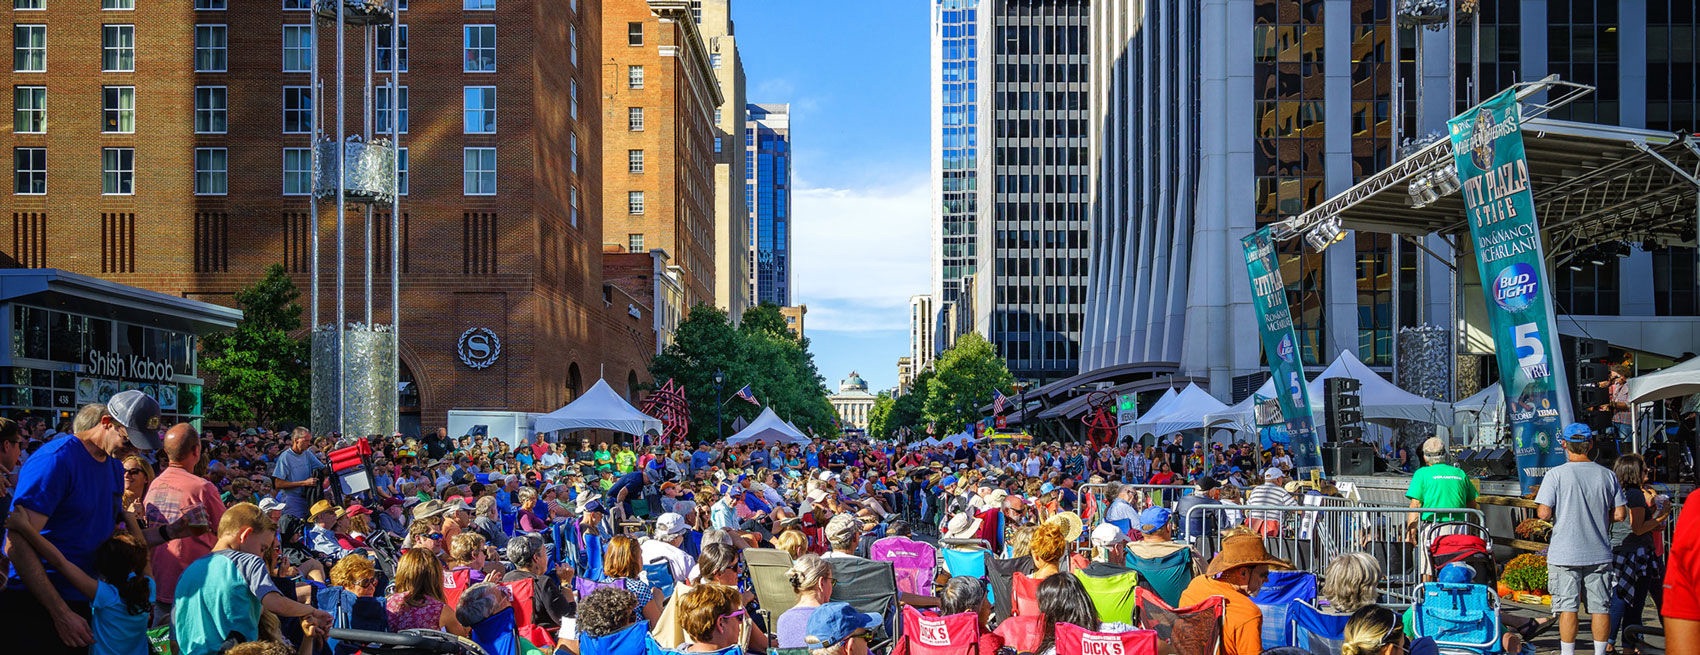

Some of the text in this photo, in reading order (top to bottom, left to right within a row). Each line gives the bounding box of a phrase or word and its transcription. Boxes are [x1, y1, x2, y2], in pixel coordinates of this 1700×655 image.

[1485, 158, 1529, 202] PLAZA
[1475, 197, 1517, 228] STAGE
[1498, 282, 1536, 300] LIGHT
[1500, 273, 1530, 289] BUD
[468, 334, 490, 359] S
[1515, 322, 1545, 367] 5
[88, 349, 174, 380] Shish Kabob
[1522, 363, 1551, 379] WRAL
